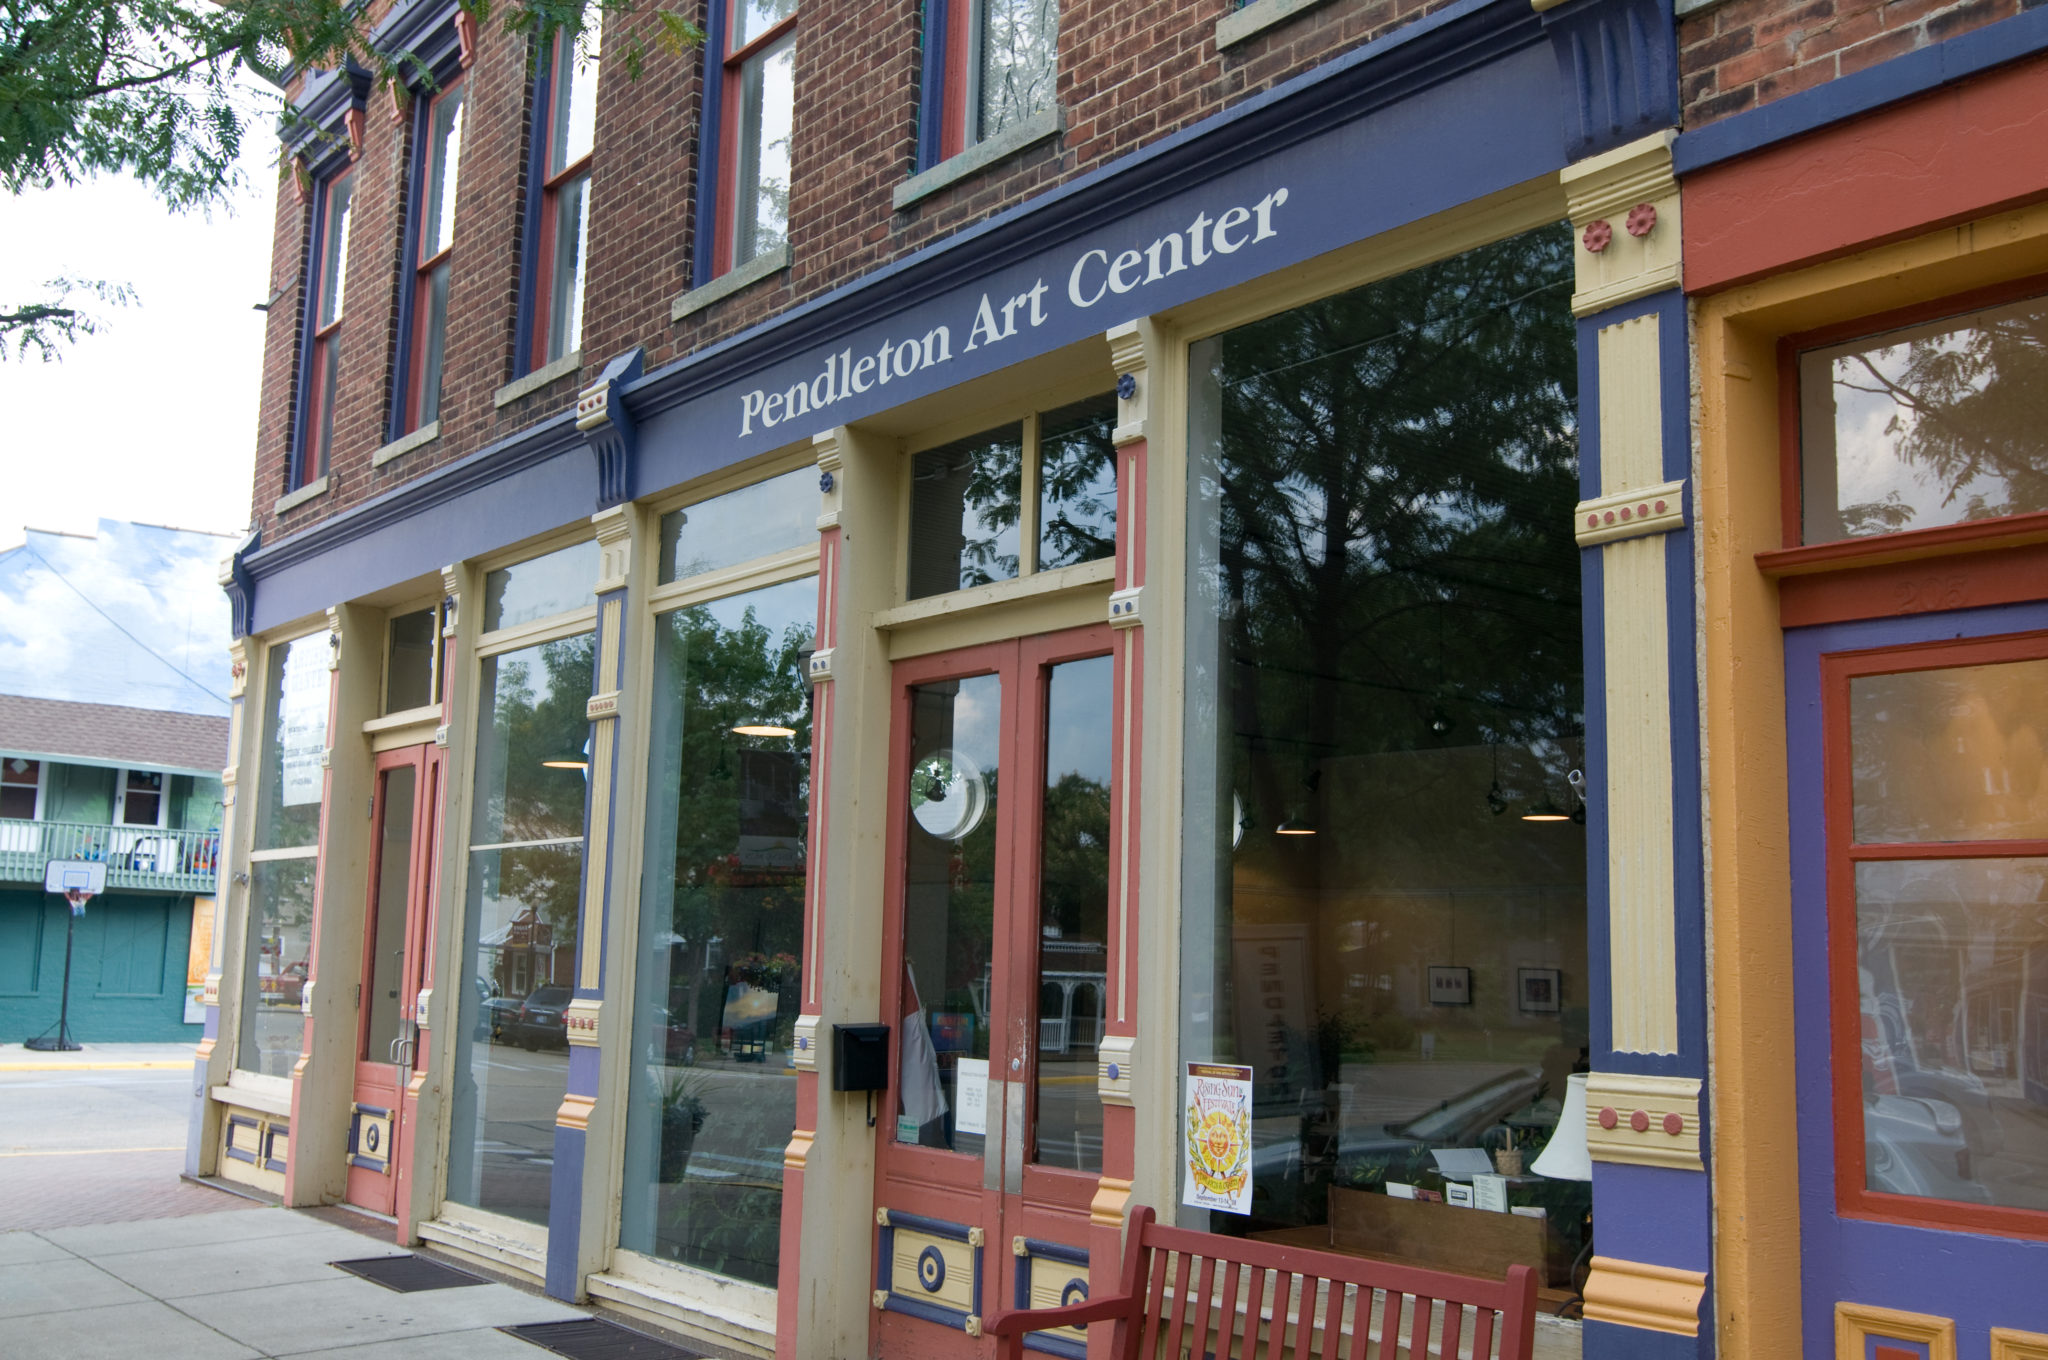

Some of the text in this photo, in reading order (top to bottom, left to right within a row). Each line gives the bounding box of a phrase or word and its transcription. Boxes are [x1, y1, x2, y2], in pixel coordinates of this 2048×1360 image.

[738, 186, 1289, 438] Pendleton Art Center
